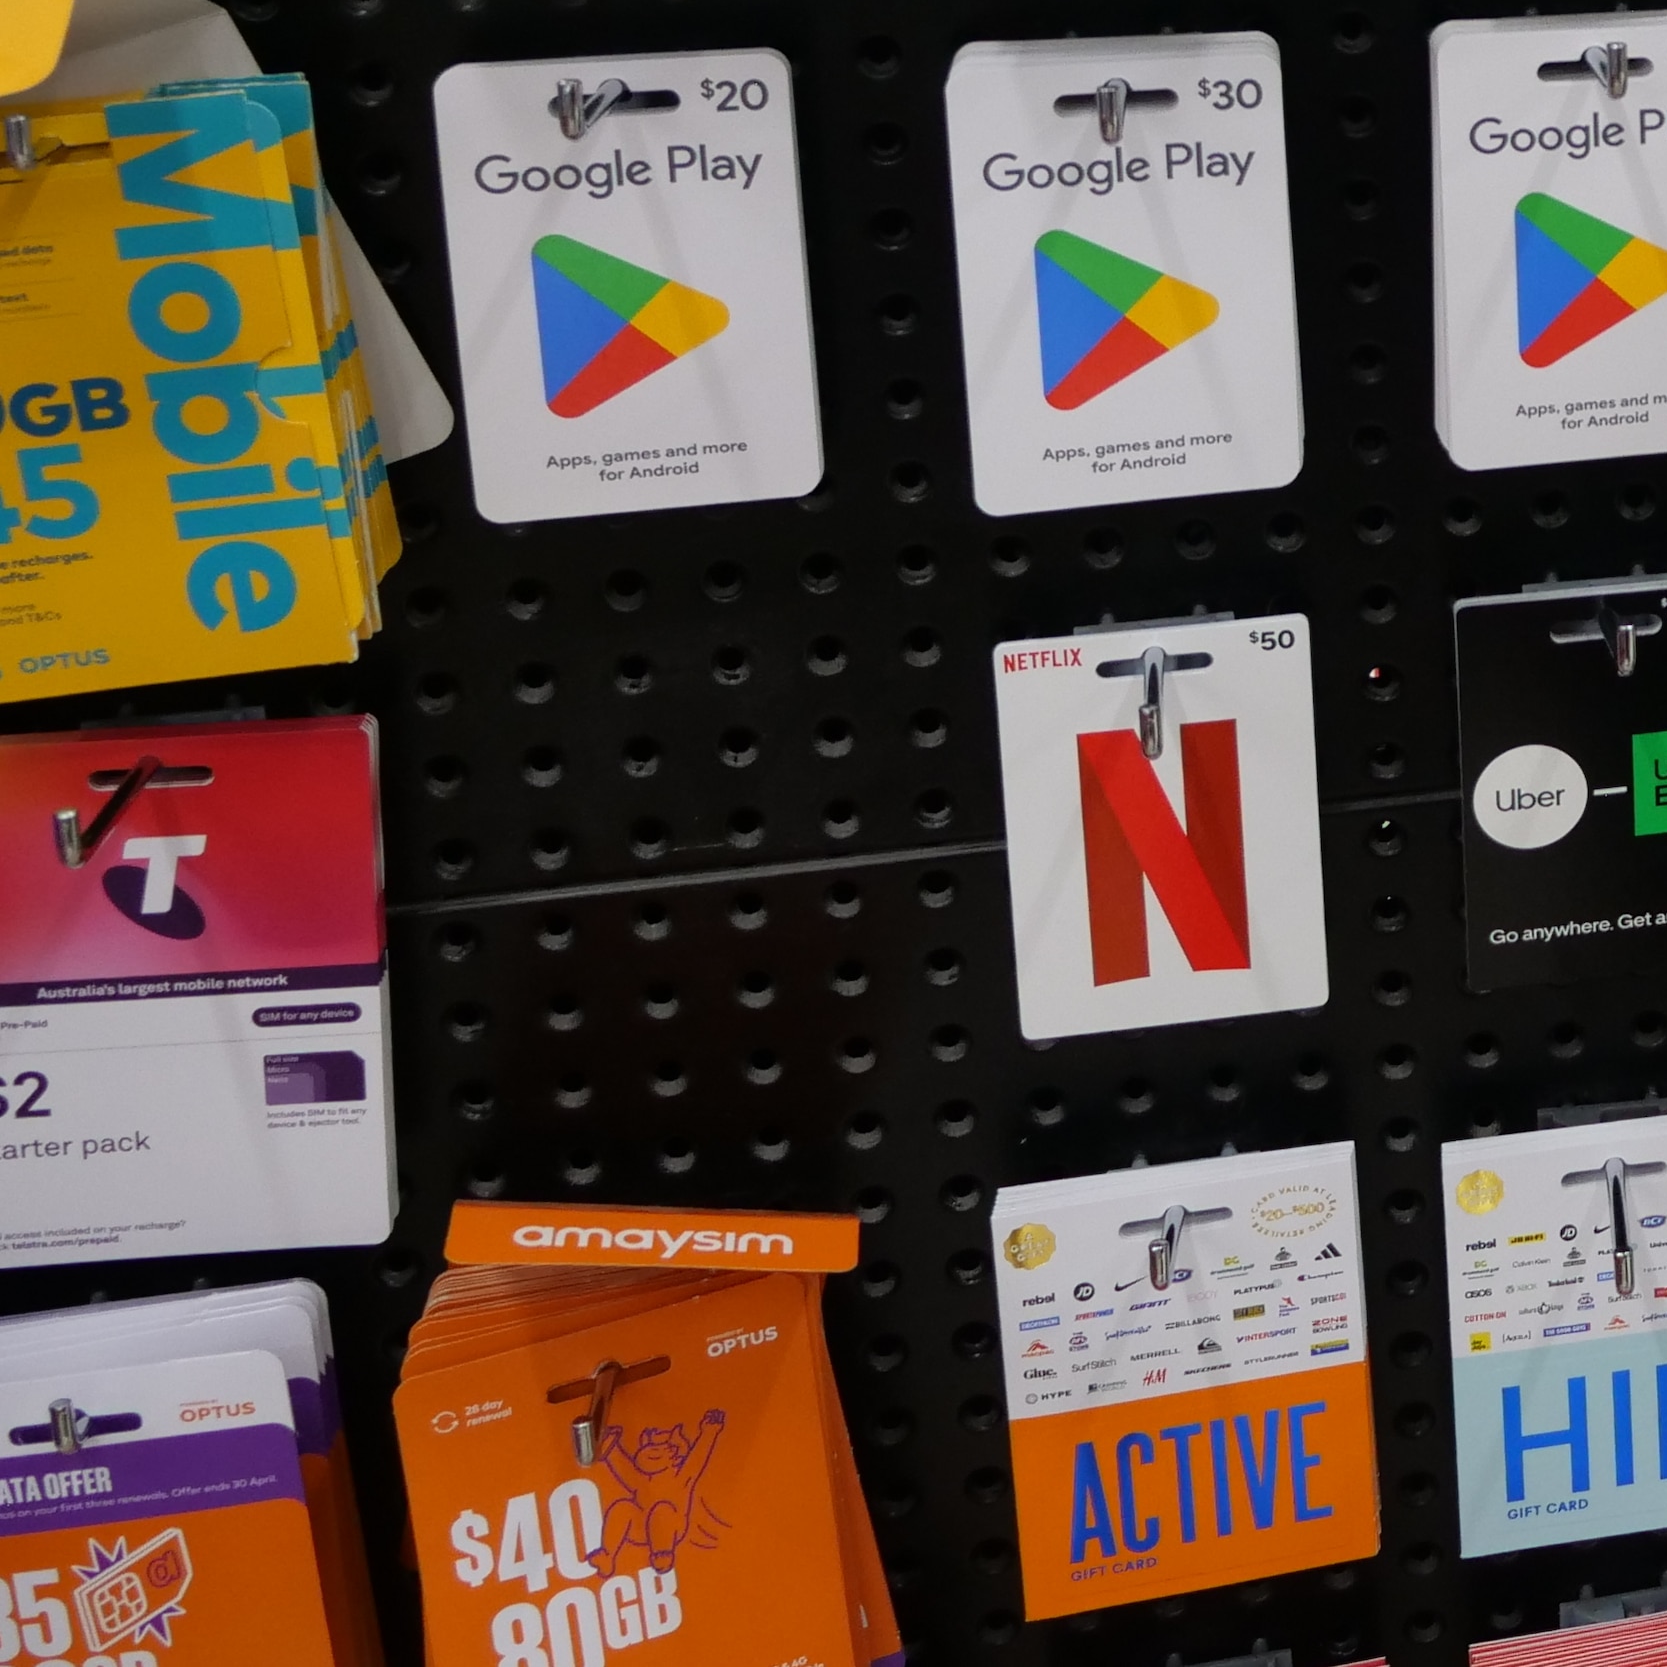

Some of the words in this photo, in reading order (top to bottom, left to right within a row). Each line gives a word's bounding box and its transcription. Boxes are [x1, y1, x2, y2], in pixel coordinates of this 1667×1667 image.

[700, 78, 770, 113] $20
[473, 146, 653, 200] Google
[667, 143, 764, 189] Play
[105, 90, 352, 635] Mobile
[546, 454, 597, 470] Apps,
[602, 448, 661, 466] games
[666, 444, 697, 458] and
[702, 441, 748, 454] more
[599, 469, 624, 482] for
[630, 462, 700, 480] Android
[1248, 628, 1296, 652] $50
[1003, 647, 1083, 674] NETFLIX
[1495, 788, 1565, 812] Uber
[1489, 929, 1518, 944] Go
[1522, 920, 1615, 941] anywhere.
[1617, 913, 1652, 929] Get
[36, 983, 116, 999] Australia's
[117, 982, 169, 996] largest
[173, 977, 223, 991] mobile
[228, 974, 289, 988] network
[82, 1131, 151, 1159] pack
[512, 1220, 794, 1260] amaysim
[707, 1325, 779, 1358] OPTUS
[179, 1401, 256, 1423] OPTUS
[44, 1466, 113, 1501] OFFER
[1069, 1400, 1334, 1565] ACTIVE
[450, 1477, 605, 1590] $40
[1071, 1564, 1107, 1582] GIFT
[1111, 1556, 1158, 1575] CARD
